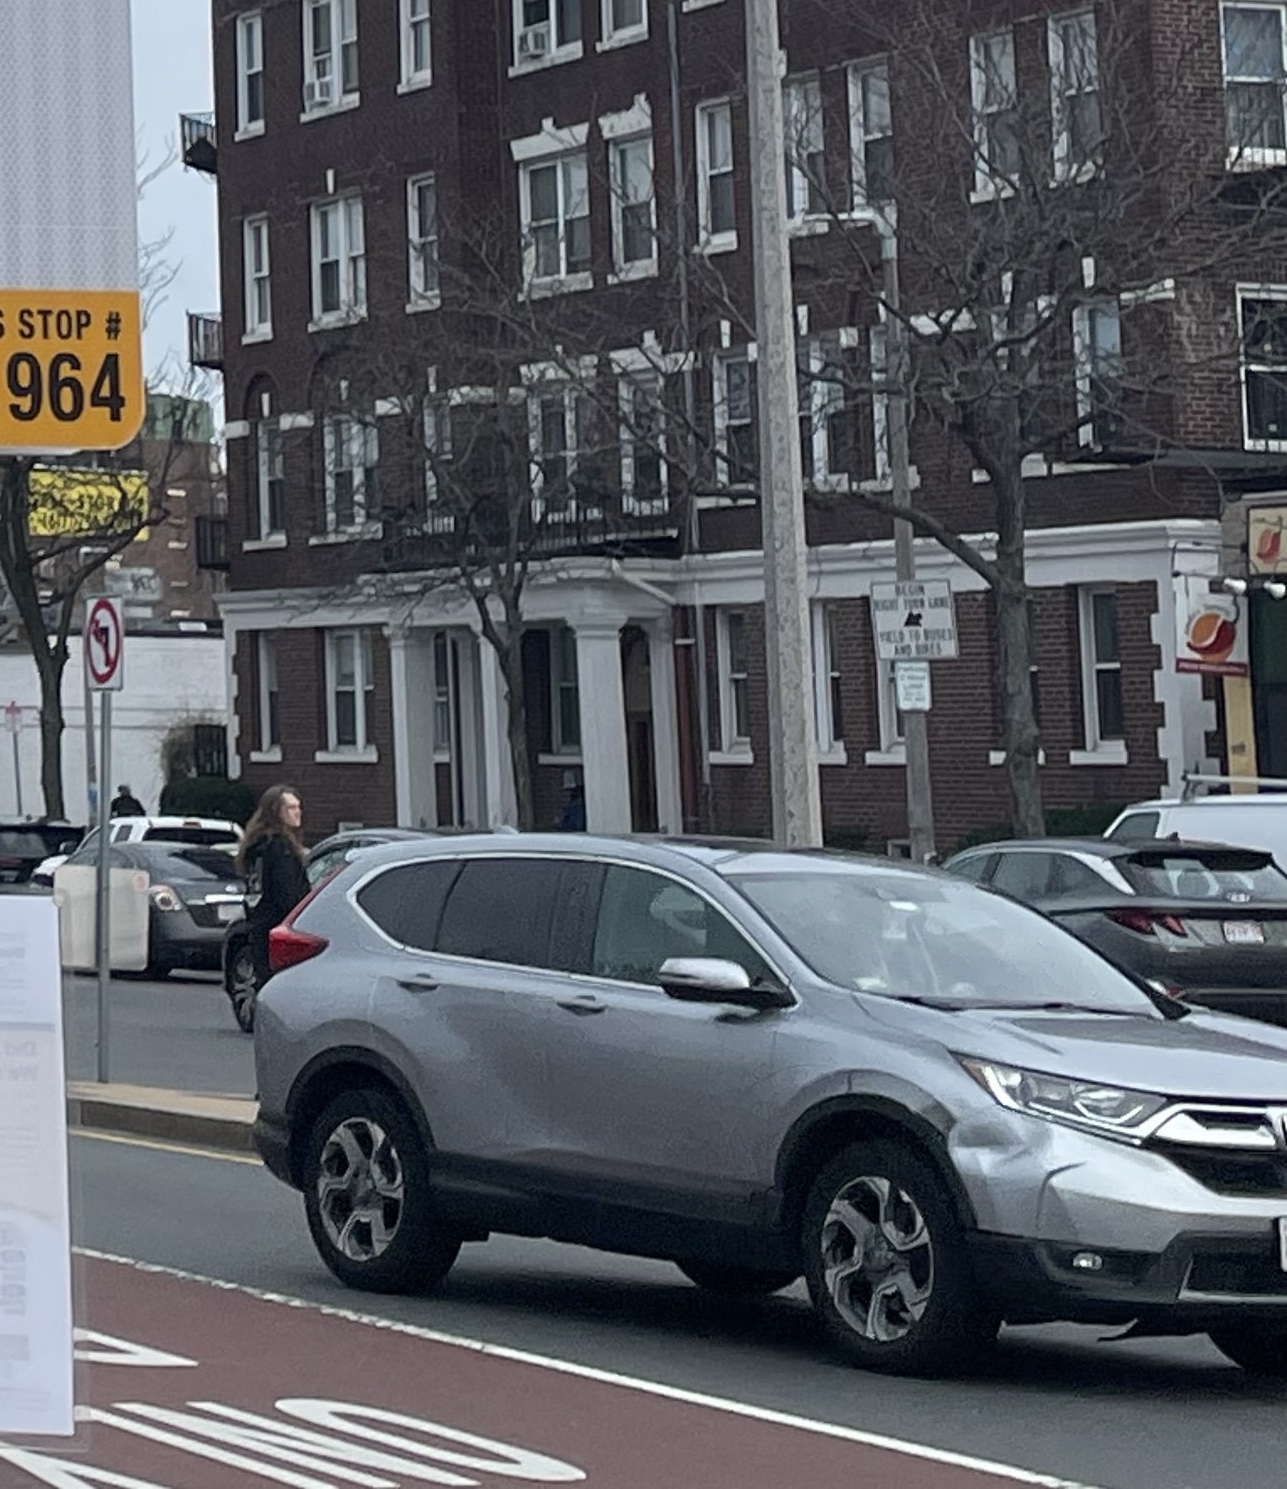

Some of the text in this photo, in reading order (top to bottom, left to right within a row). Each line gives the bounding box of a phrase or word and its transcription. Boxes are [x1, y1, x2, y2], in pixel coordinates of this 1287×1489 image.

[18, 309, 92, 340] STOP
[105, 311, 122, 341] #
[6, 351, 126, 422] 964
